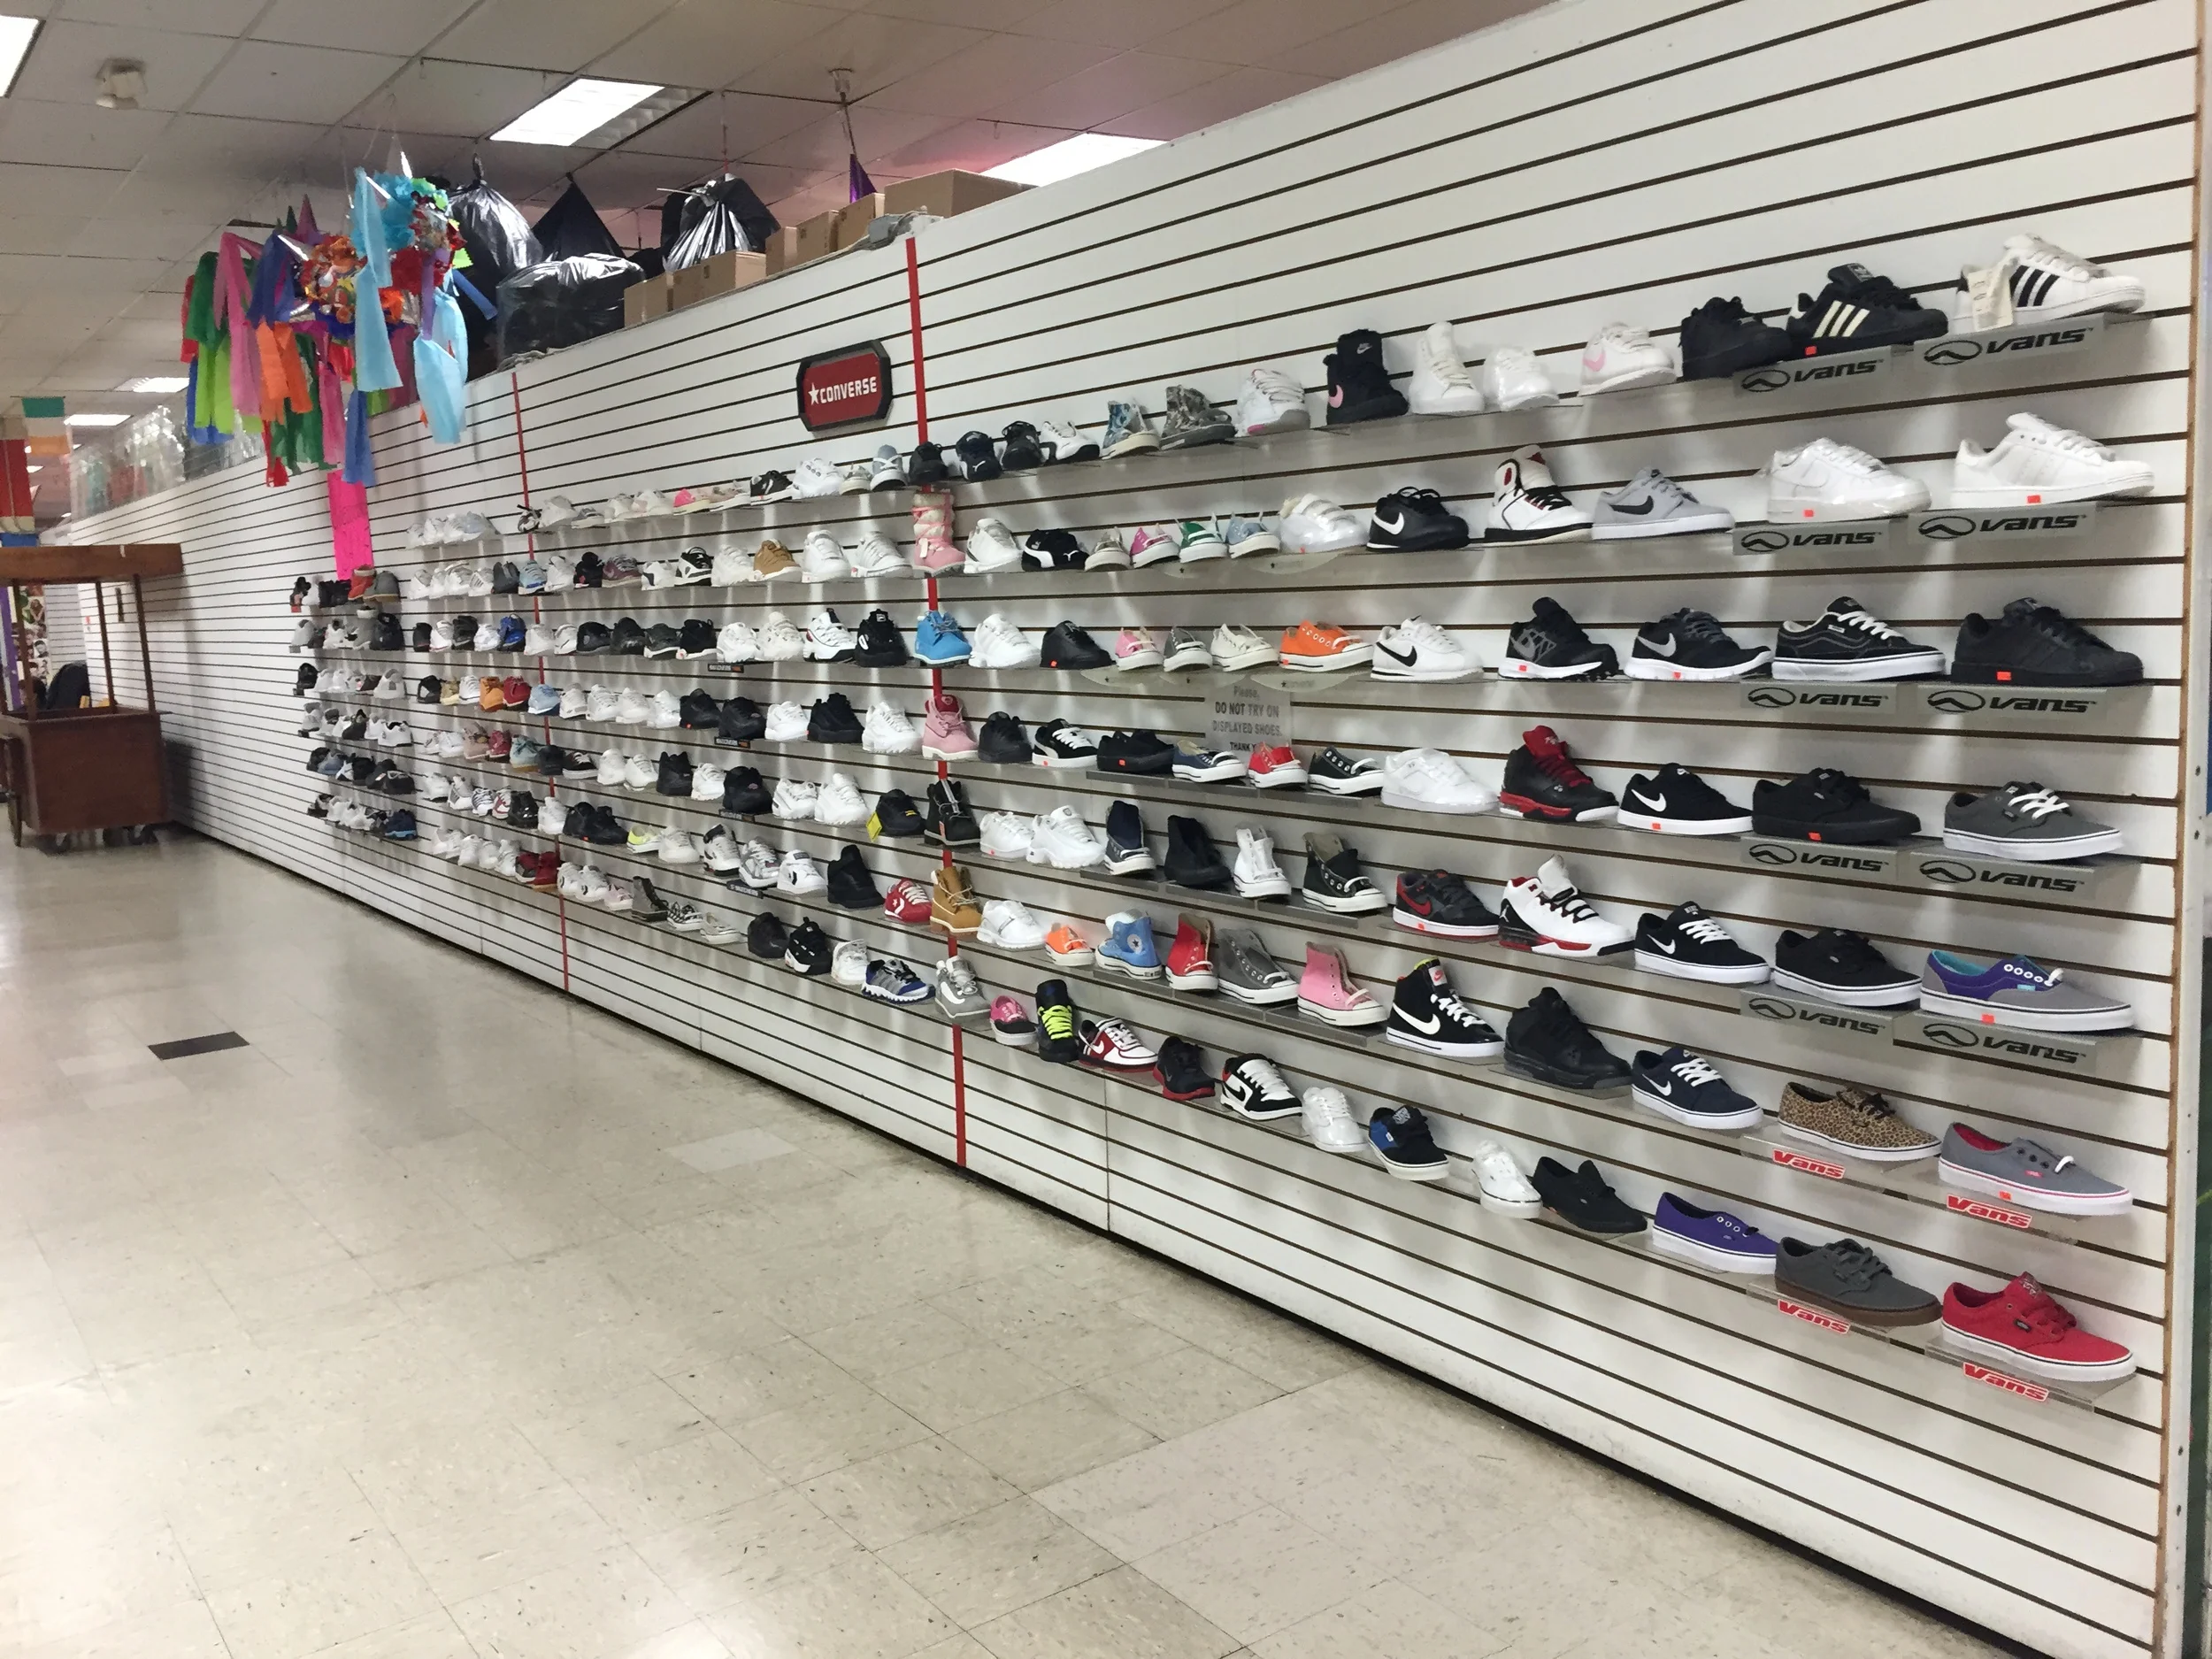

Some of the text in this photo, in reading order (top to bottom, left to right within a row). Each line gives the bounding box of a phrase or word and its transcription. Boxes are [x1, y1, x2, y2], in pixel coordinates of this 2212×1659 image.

[819, 376, 877, 403] CONVERSE
[1215, 702, 1279, 718] DO NOT TRY ON
[1212, 720, 1253, 733] DISPLAYED
[1230, 741, 1250, 751] THANK
